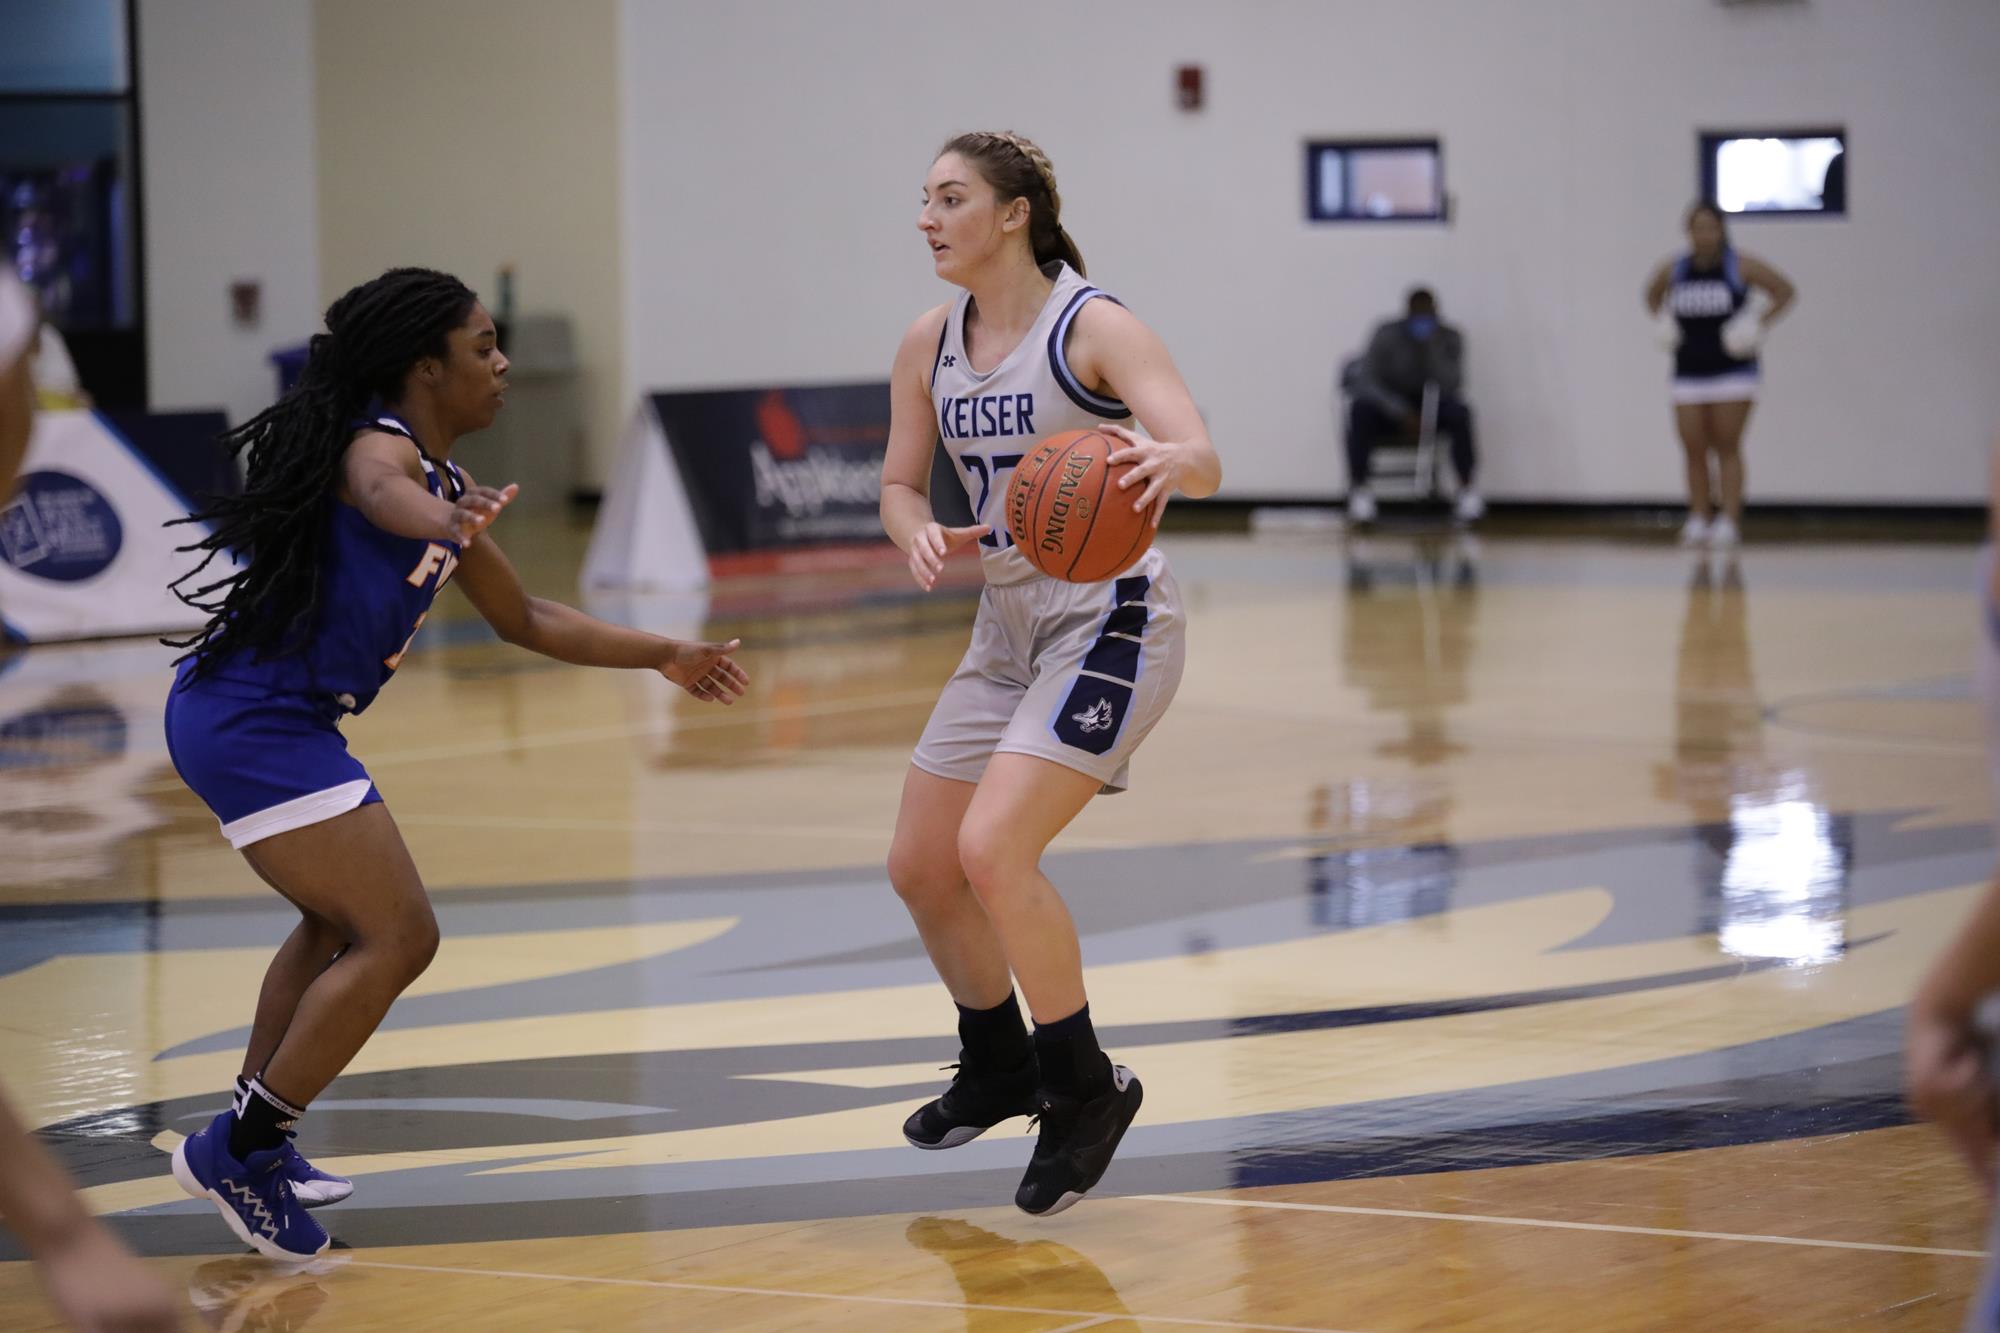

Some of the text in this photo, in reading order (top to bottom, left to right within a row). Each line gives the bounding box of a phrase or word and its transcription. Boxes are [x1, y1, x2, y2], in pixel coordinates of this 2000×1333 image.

[942, 393, 1035, 438] KEISER
[1014, 479, 1031, 541] 1000
[1041, 451, 1094, 555] SPALDING
